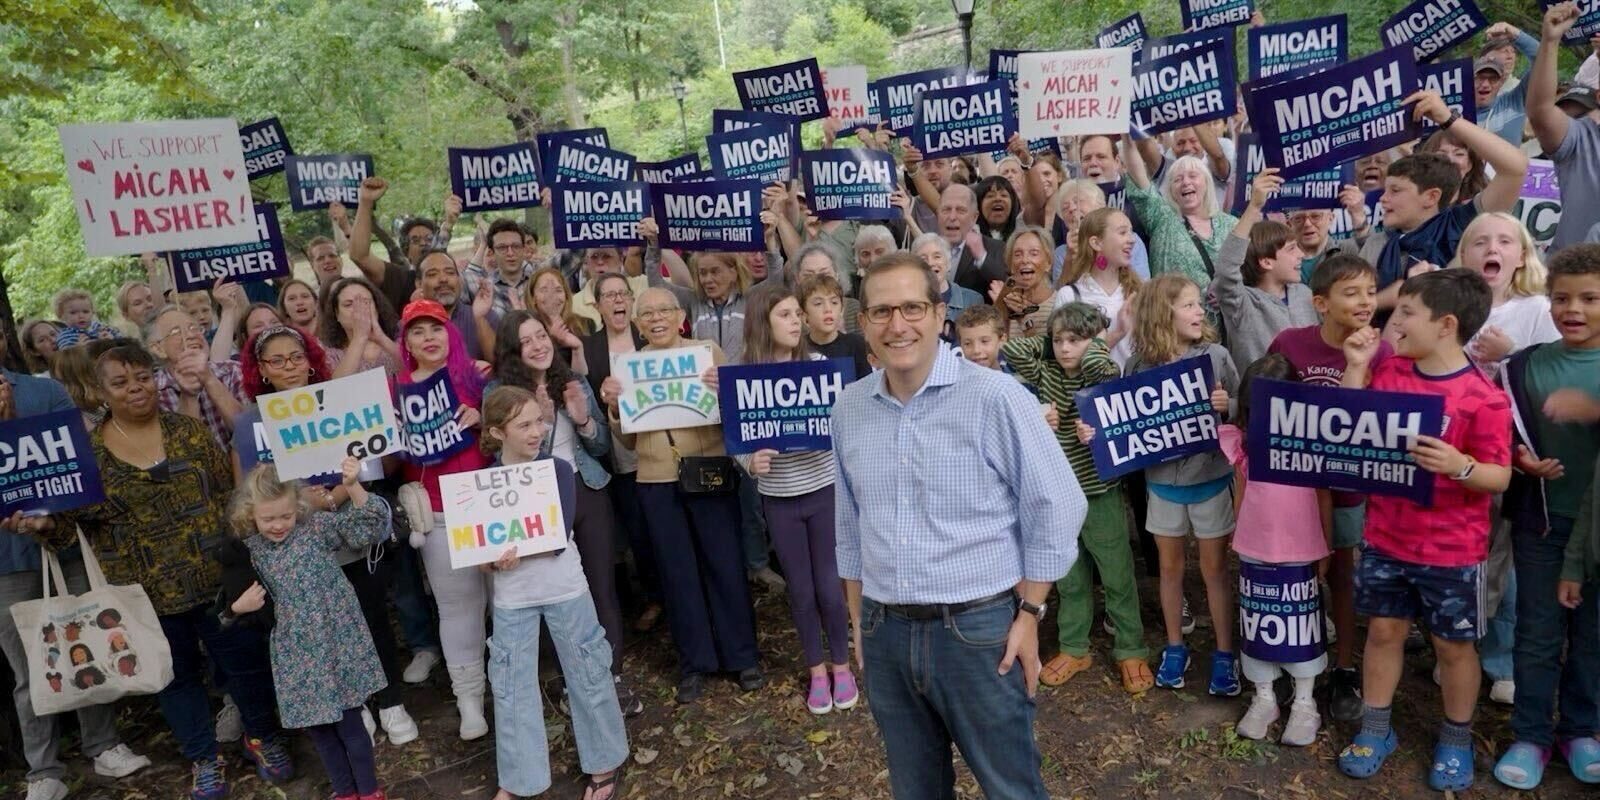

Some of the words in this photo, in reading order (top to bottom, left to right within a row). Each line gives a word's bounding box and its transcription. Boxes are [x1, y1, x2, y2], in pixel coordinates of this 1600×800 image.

[1192, 5, 1250, 32] LASHER
[1099, 18, 1141, 48] MICAH
[1260, 24, 1337, 59] MICAH
[1413, 14, 1477, 61] ASHER
[1041, 60, 1056, 73] WE
[1063, 55, 1115, 73] SUPPORT
[1283, 49, 1337, 63] CONGRESS
[744, 66, 814, 99] MICAH
[1044, 74, 1098, 95] MICAH
[1130, 51, 1219, 102] MICAH
[768, 90, 815, 104] CONGRESS
[923, 89, 1002, 124] MICAH
[1133, 98, 1154, 110] FOR
[1157, 80, 1220, 102] CONGRESS
[1274, 60, 1402, 134] MICAH
[830, 105, 864, 119] CAH
[892, 115, 914, 130] READ
[1037, 98, 1102, 121] LASHER
[1134, 89, 1224, 130] LASHER
[1281, 129, 1312, 145] FOR
[1317, 99, 1402, 134] CONGRESS
[924, 122, 944, 132] FOR
[947, 116, 1002, 130] CONGRESS
[92, 137, 128, 160] WE
[139, 134, 222, 158] SUPPORT
[240, 125, 280, 153] CAH
[720, 132, 790, 169] MICAH
[925, 124, 1005, 153] LASHER
[1282, 135, 1330, 168] READY
[1332, 133, 1347, 147] FOR
[1346, 131, 1361, 144] THE
[1362, 110, 1407, 142] FIGHT
[297, 161, 367, 181] MICAH
[461, 149, 535, 180] MICAH
[558, 145, 629, 180] MICAH
[726, 167, 747, 177] FOR
[811, 160, 892, 186] MICAH
[464, 179, 485, 188] FOR
[488, 173, 537, 186] CONGRESS
[815, 186, 833, 194] FOR
[1305, 181, 1341, 198] FIGHT
[301, 187, 361, 205] LASHE
[465, 181, 540, 207] LASHER
[563, 189, 643, 214] MICAH
[664, 190, 751, 219] MICAH
[815, 194, 843, 212] READY
[863, 193, 892, 209] FIGHT
[566, 221, 645, 242] LASHER
[669, 227, 702, 242] READY
[722, 227, 753, 242] FIGHT
[692, 218, 751, 226] CONGRESS
[181, 251, 202, 260] FOR
[206, 242, 272, 257] CONGRESS
[183, 251, 276, 284] LASHER
[628, 354, 697, 379] TEAM
[621, 381, 717, 417] LASHER
[736, 372, 842, 410] MICAH
[1094, 368, 1209, 428] MICAH
[265, 389, 325, 421] GO!
[740, 410, 766, 420] FOR
[771, 407, 832, 418] CONGRES
[279, 403, 384, 450] MICAH
[740, 420, 781, 442] READY
[782, 423, 795, 433] FOR
[795, 422, 807, 432] THE
[808, 417, 832, 436] FIG
[1104, 424, 1132, 438] FOR
[1136, 403, 1211, 429] CONGRESS
[1269, 396, 1422, 450] MICAH
[0, 425, 77, 474] CAH
[346, 427, 394, 460] GO!
[1107, 414, 1217, 466] LASHER
[1270, 437, 1305, 450] FOR
[1311, 442, 1416, 462] CONGRESS
[0, 461, 79, 485] ONGRESS
[474, 466, 533, 491] LET'S
[1269, 449, 1324, 473] READY
[1326, 460, 1344, 471] FOR
[1344, 462, 1360, 474] THE
[1363, 461, 1417, 486] FIGHT
[2, 491, 18, 502] FOR
[19, 486, 34, 498] THE
[35, 472, 83, 498] FIGHT
[489, 490, 520, 508] GO
[1253, 585, 1265, 595] THE
[1266, 587, 1279, 597] FOR
[1240, 606, 1321, 646] MICA
